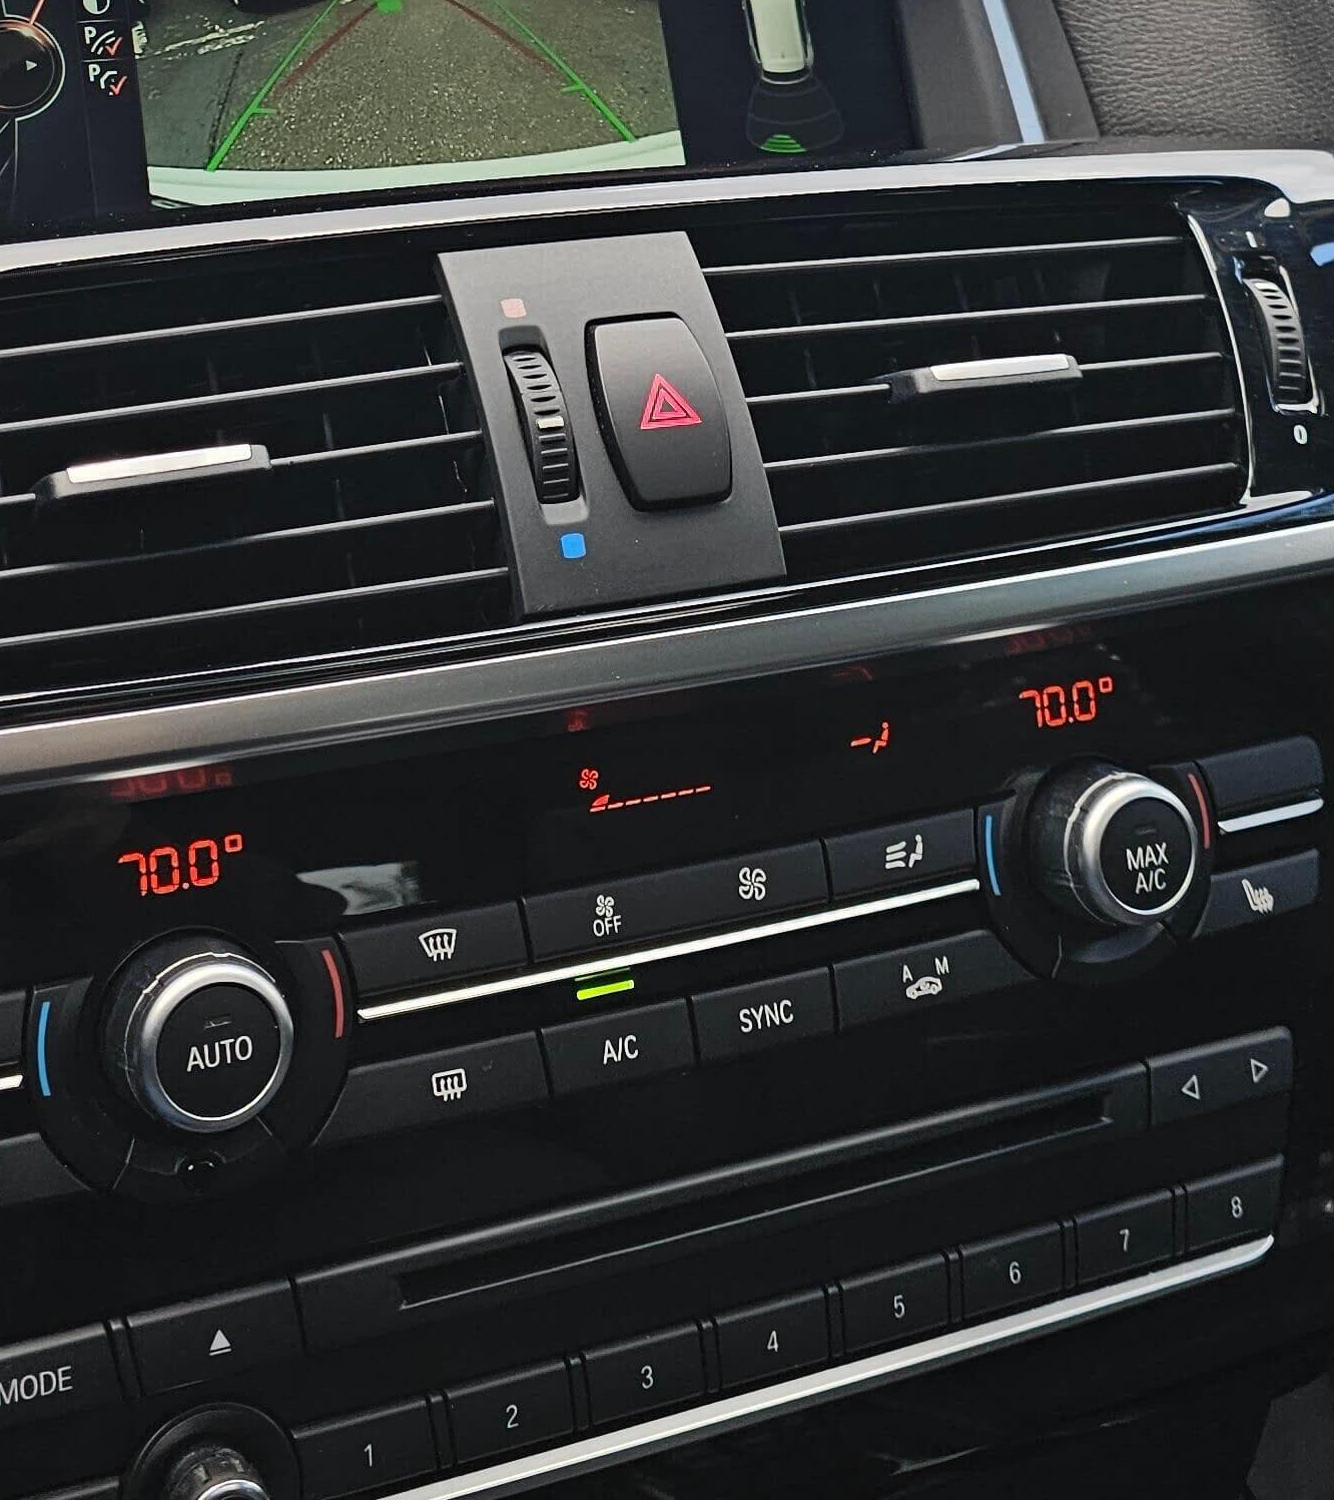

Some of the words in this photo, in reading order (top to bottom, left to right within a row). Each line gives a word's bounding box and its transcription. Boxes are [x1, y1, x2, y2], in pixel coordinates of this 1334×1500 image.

[1126, 841, 1169, 871] MAX
[1135, 869, 1167, 894] A/C
[593, 915, 622, 937] OFF
[901, 964, 914, 983] A
[934, 956, 950, 976] M
[740, 1000, 793, 1032] SYNC
[187, 1036, 252, 1071] AUTO
[604, 1035, 638, 1064] A/C
[1232, 1196, 1242, 1218] 8
[1120, 1229, 1129, 1250] 7
[1010, 1262, 1020, 1284] 6
[894, 1295, 904, 1317] 5
[768, 1331, 778, 1351] 4
[641, 1366, 653, 1388] 3
[506, 1405, 518, 1428] 2
[365, 1444, 372, 1466] 1
